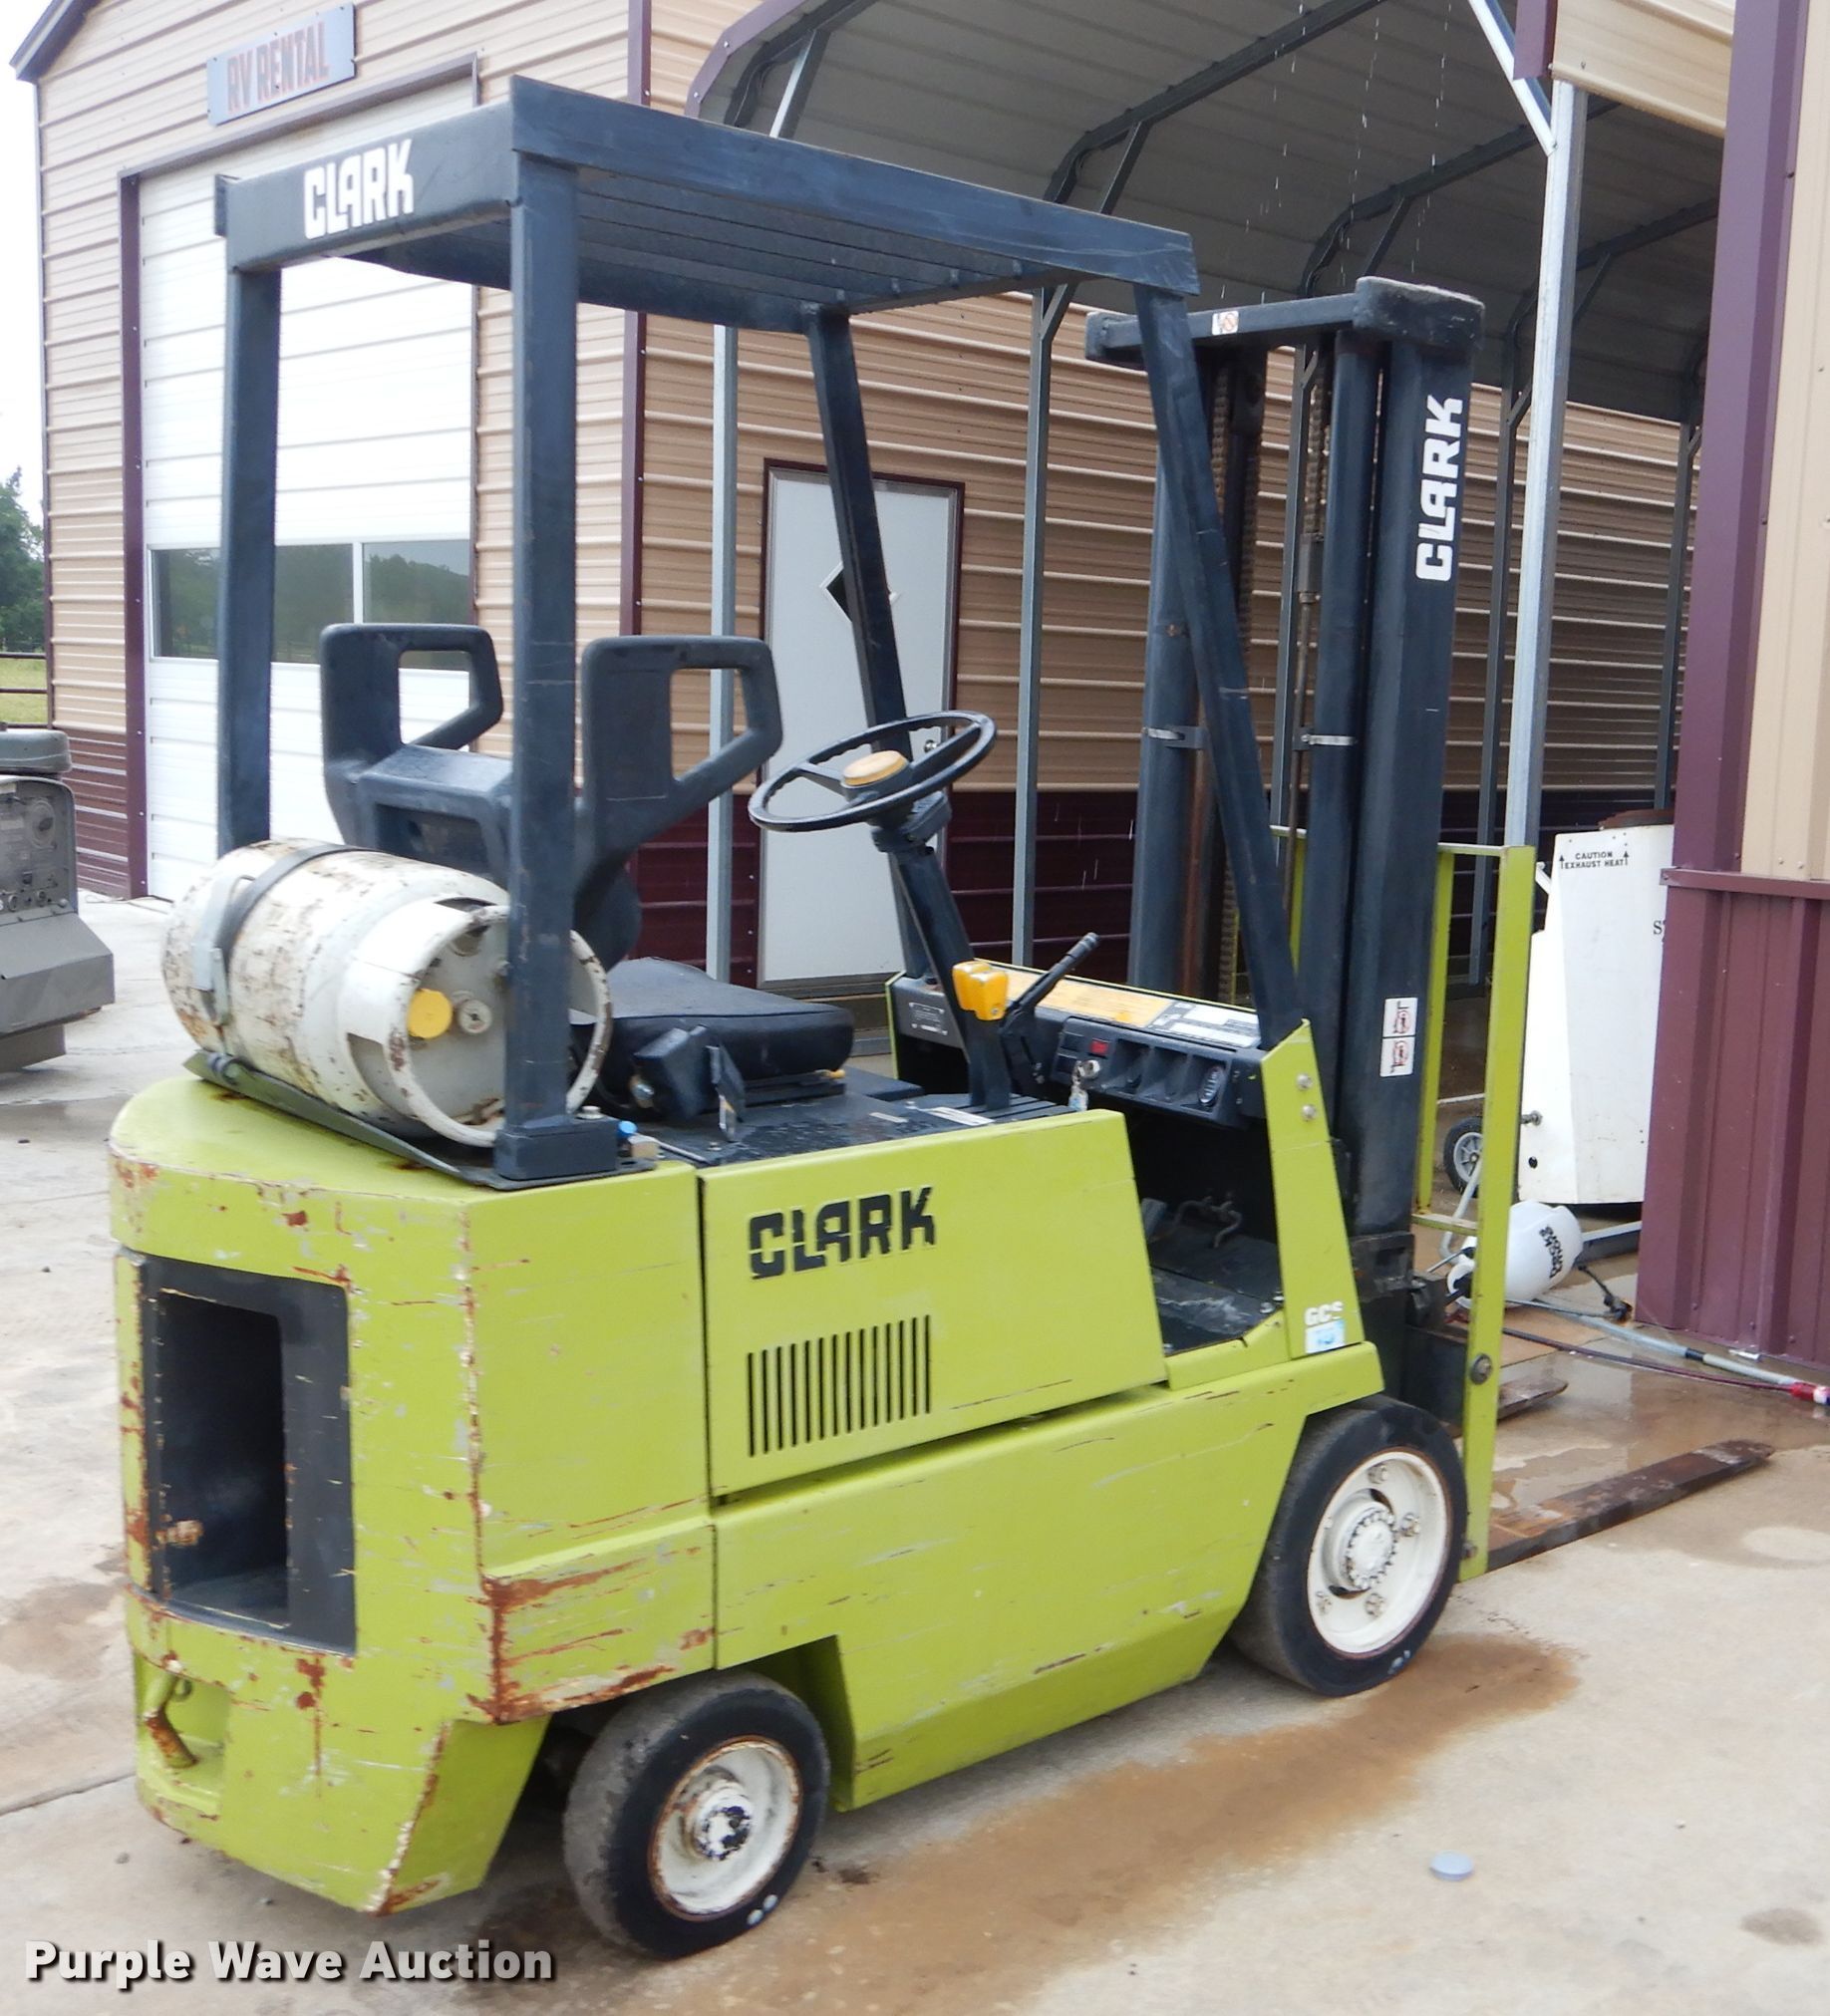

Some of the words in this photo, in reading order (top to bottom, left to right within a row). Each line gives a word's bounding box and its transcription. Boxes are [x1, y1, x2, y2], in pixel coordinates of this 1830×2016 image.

[226, 50, 254, 116] RV
[256, 21, 330, 103] RENTAL
[303, 138, 415, 240] CLARK
[1415, 394, 1463, 582] CLARK
[1564, 860, 1602, 870] EXHAUST
[1604, 858, 1625, 868] HEAT
[1575, 850, 1614, 861] CAUTION
[750, 1186, 935, 1280] CLARK
